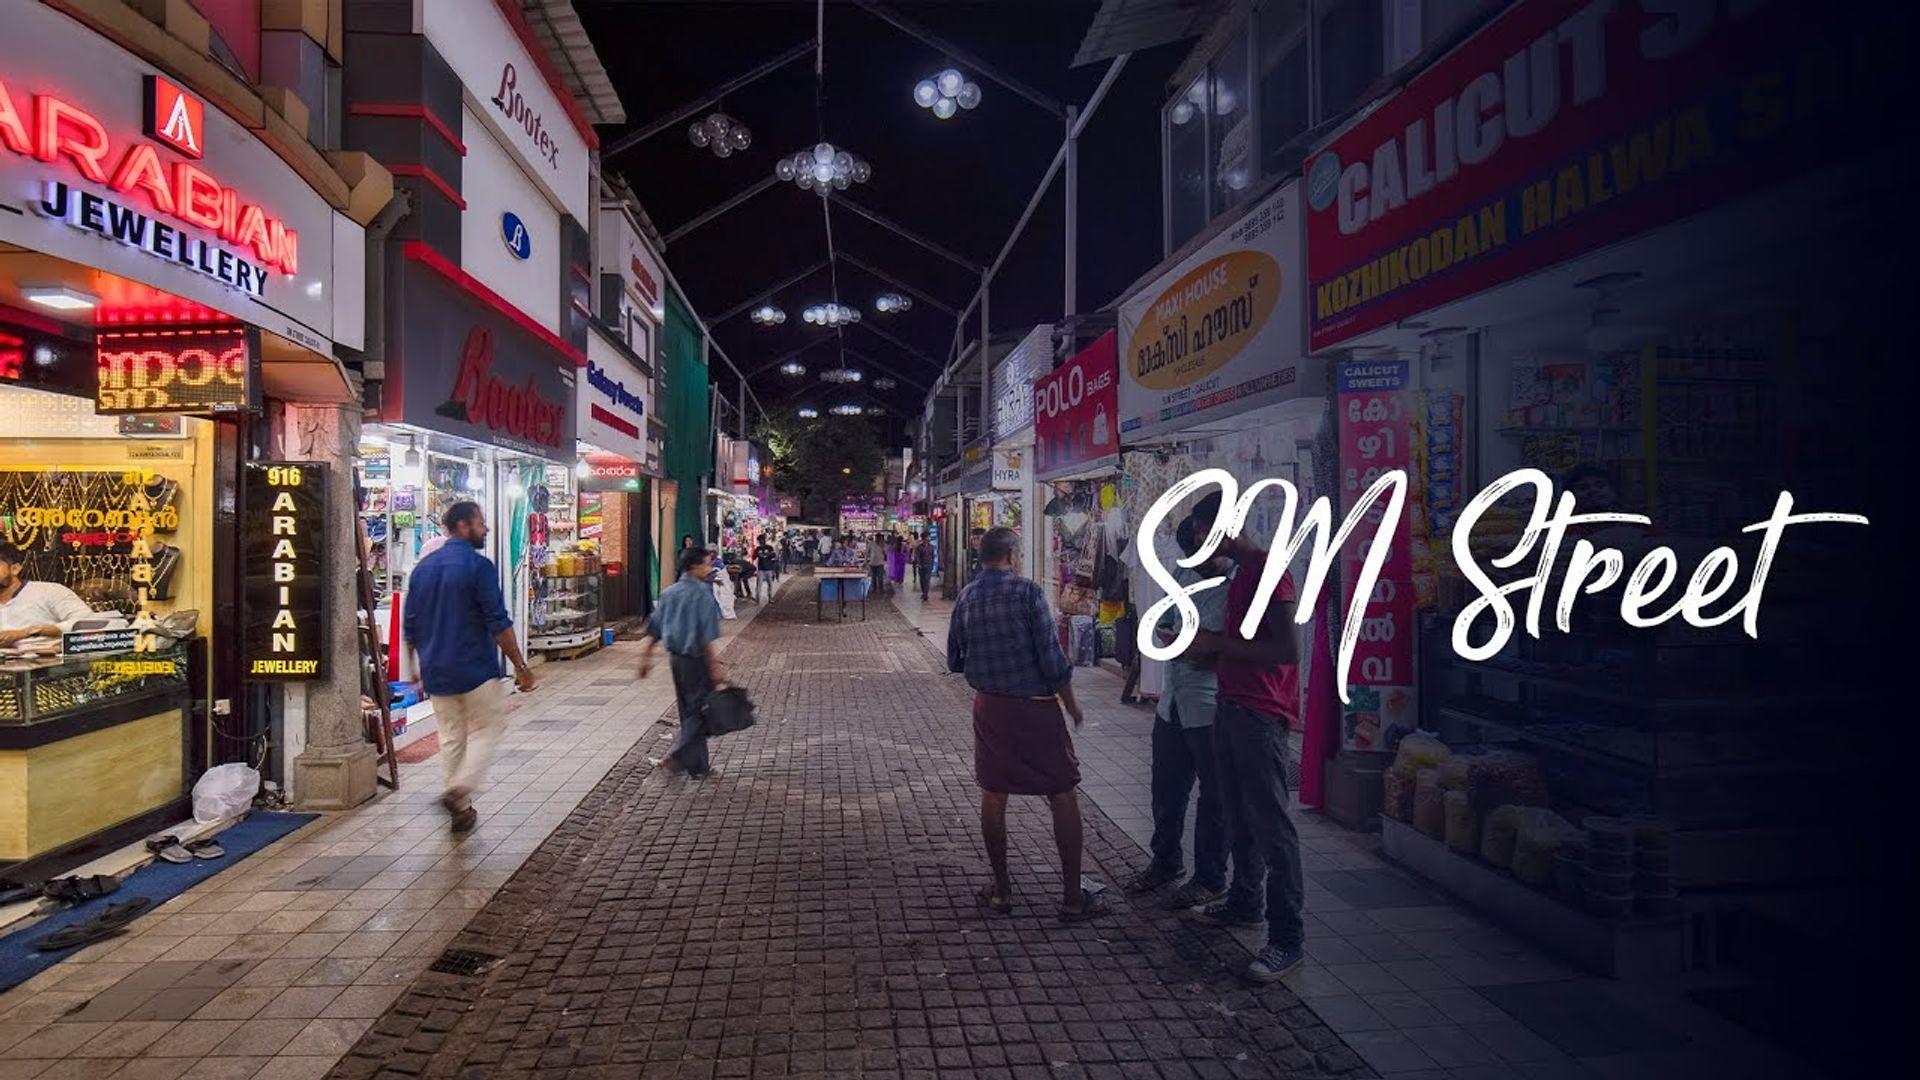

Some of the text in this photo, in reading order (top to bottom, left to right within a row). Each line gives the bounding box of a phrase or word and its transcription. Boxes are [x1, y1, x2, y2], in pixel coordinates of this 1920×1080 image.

[491, 63, 559, 170] Bootex
[1337, 0, 1607, 235] CALICUT
[34, 180, 268, 297] JEWELLERY
[1316, 104, 1713, 320] KOZHIKODAN HALWA
[1184, 261, 1229, 306] HOUSE
[436, 325, 566, 449] Bootex
[1035, 364, 1112, 424] POLO BAGS
[1345, 366, 1399, 378] CALICUT
[267, 467, 301, 487] 916
[994, 468, 1021, 481] HYRA
[271, 491, 297, 653] ARABIAN
[251, 659, 318, 675] JEWELLERY
